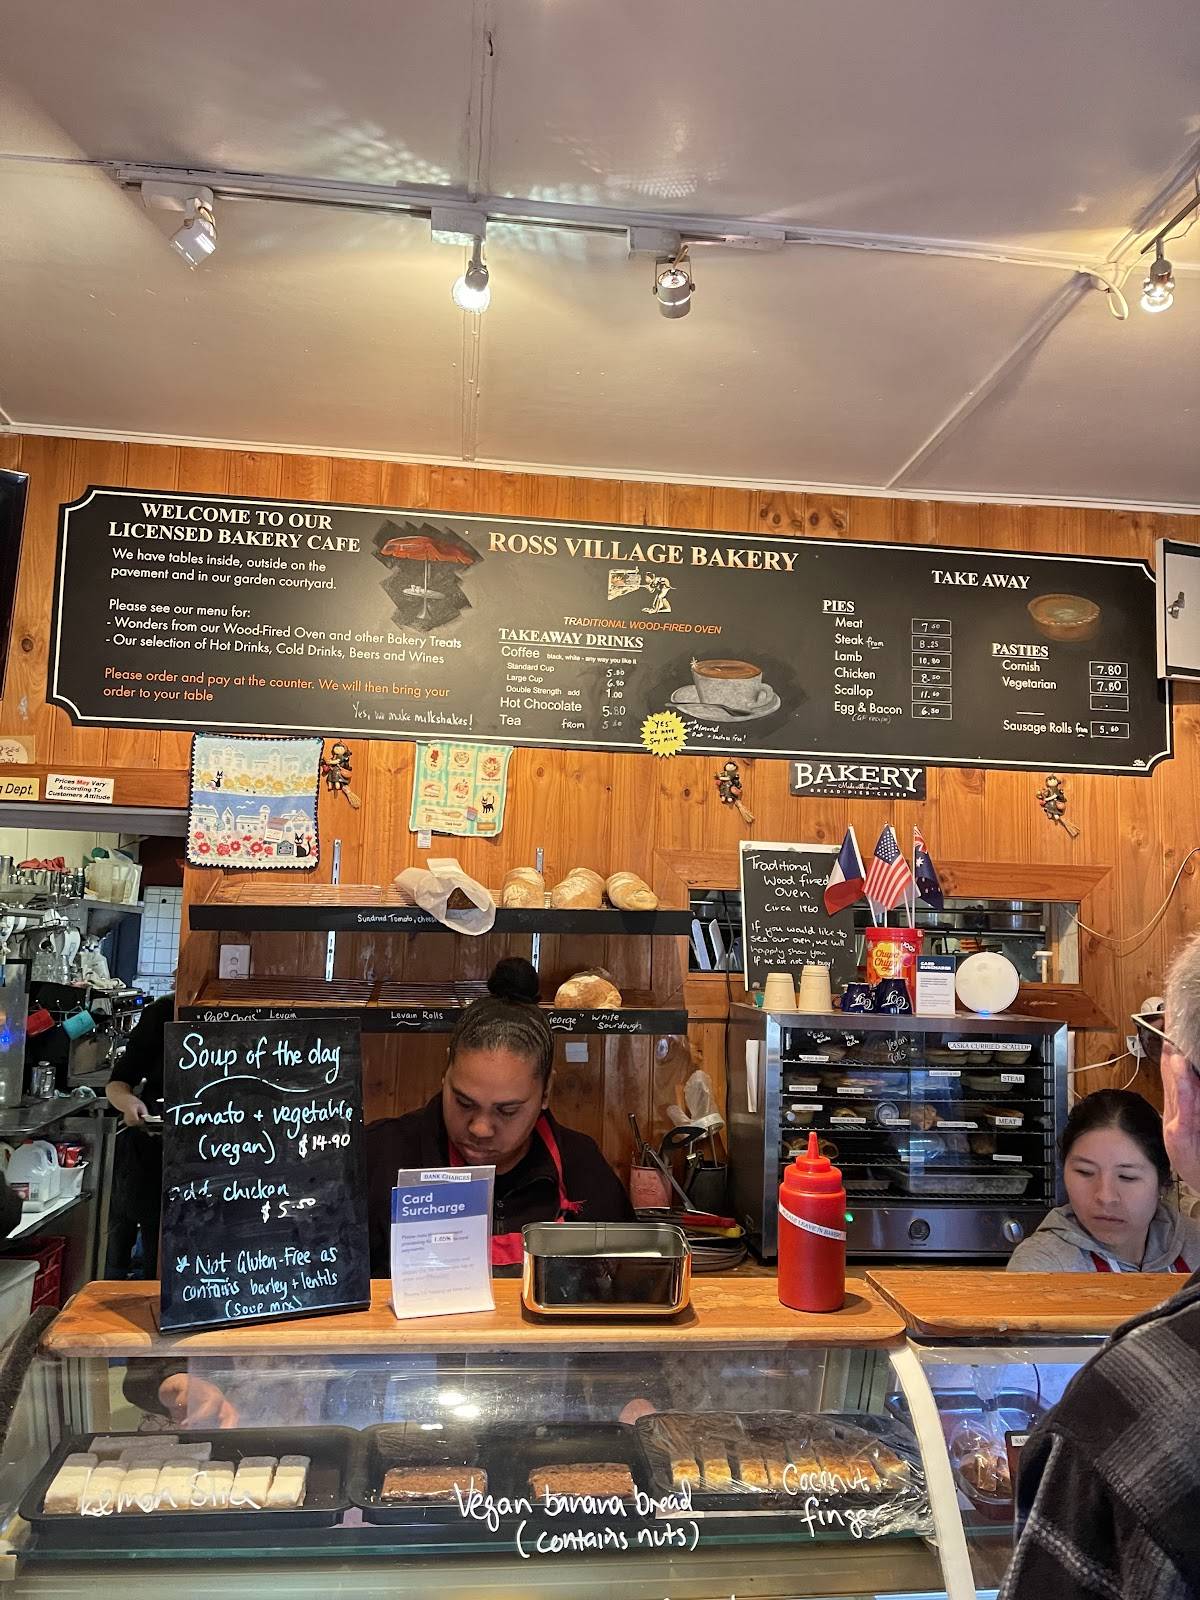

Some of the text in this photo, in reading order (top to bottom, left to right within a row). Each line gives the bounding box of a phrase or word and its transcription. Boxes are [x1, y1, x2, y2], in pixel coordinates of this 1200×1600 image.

[141, 503, 332, 529] WELCOME TO OUR
[108, 522, 360, 552] LICENSED BAKERY CAFE
[112, 548, 326, 572] We have tables inside, outside on the
[488, 532, 800, 572] ROSS VILLAGE BAKERY
[111, 568, 337, 590] pavement and in our garden courtyard.
[932, 570, 1031, 590] TAKE AWAY
[109, 599, 251, 618] Please see our menu for:
[823, 600, 855, 612] PIES
[563, 616, 722, 634] TRADITIONAL WOOD-FIRED OVEN
[835, 617, 863, 628] Meat
[115, 616, 462, 648] Wonders from our Wood-Fired Oven and other Bakery Treats
[499, 628, 644, 649] TAKEAWAY DRINKS
[113, 634, 444, 663] Our selection of Hot Drinks, Cold Drinks, Beers and Wines
[835, 634, 884, 648] Steak from
[501, 646, 540, 658] Coffee
[835, 650, 862, 661] Lamb
[992, 643, 1049, 657] PASTIES
[507, 663, 538, 671] Standard
[835, 667, 876, 679] Chicken
[1002, 660, 1122, 675] Cornish 7.80
[104, 668, 450, 698] Please order and pay at the counter. We will then bring your
[529, 675, 543, 683] Cup
[1002, 677, 1122, 691] Vegetarian 7.80
[103, 685, 213, 701] order to your table
[506, 686, 531, 694] Double
[533, 687, 562, 696] Strength
[606, 689, 623, 698] 1.00
[835, 684, 873, 698] Scallop
[500, 697, 582, 711] Hot Chocolate
[834, 701, 902, 715] Egg & Bacon
[499, 714, 521, 726] Tea
[1003, 720, 1072, 734] Sausage Rolls
[795, 763, 922, 792] BAKERY
[5, 783, 33, 796] Dept.
[746, 855, 812, 874] Traditional
[764, 875, 795, 886] Wood
[752, 920, 847, 938] If you would like to
[391, 1011, 443, 1020] Levain Rolls
[179, 1032, 340, 1084] Soup of the day
[167, 1099, 352, 1139] Tomato vegetable
[199, 1131, 275, 1165] (vegan)
[223, 1179, 289, 1200] chicken
[402, 1193, 432, 1204] Card
[402, 1204, 465, 1216] Surcharge
[195, 1247, 338, 1275] Not as
[183, 1269, 338, 1301] contains barley lentils
[454, 1464, 870, 1532] Vegan banana bread Coconut
